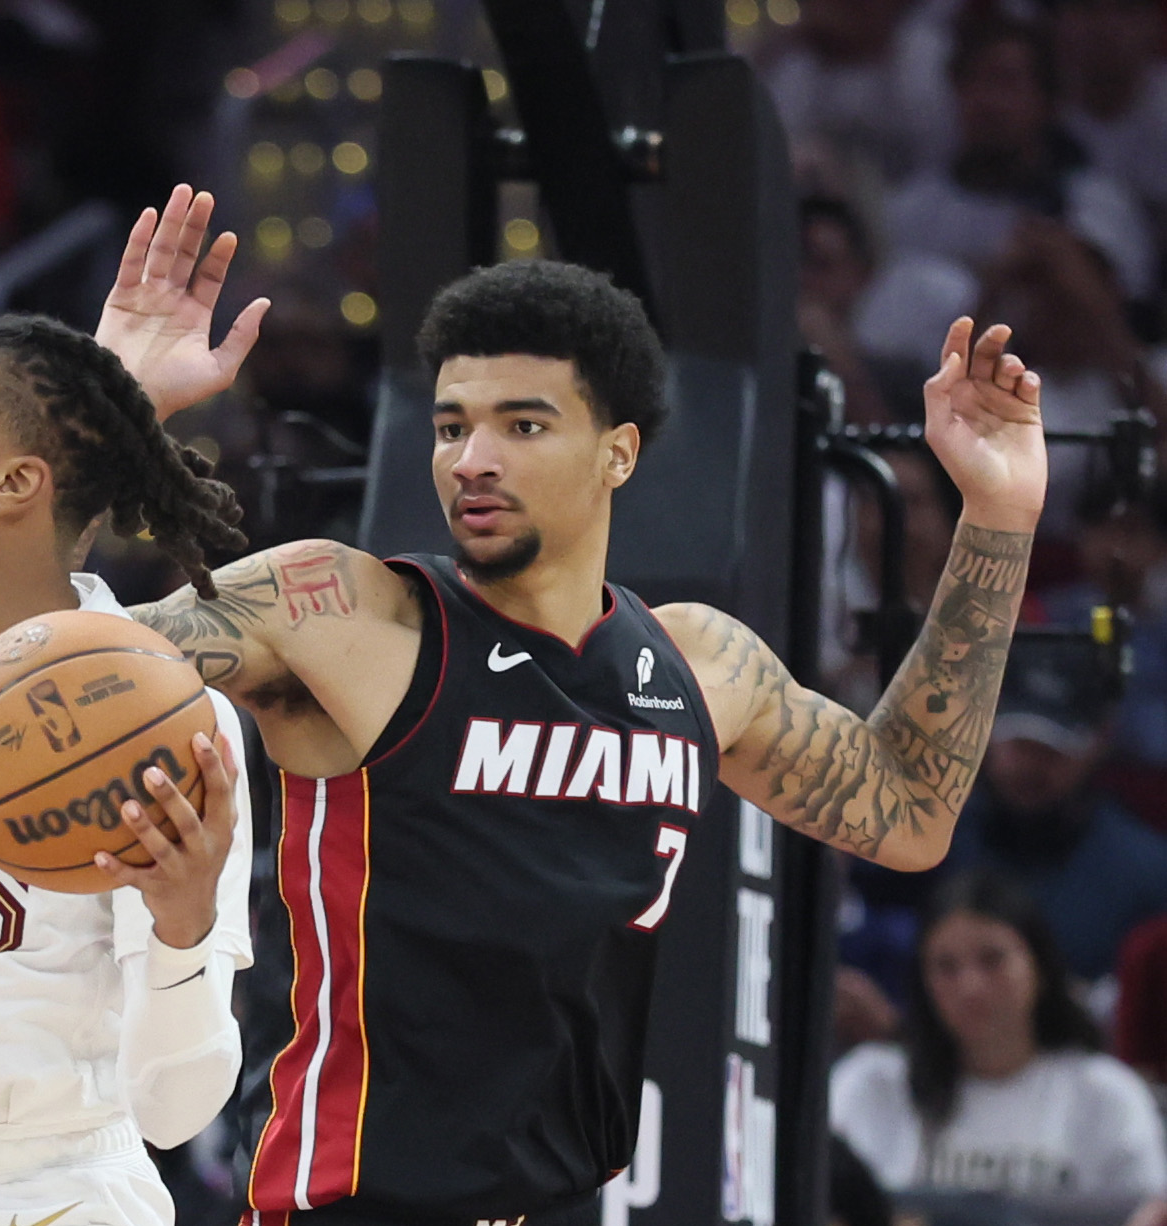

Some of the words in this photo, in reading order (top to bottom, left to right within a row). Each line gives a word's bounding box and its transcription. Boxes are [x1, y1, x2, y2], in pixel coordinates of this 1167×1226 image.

[627, 692, 685, 710] Robinhood
[3, 744, 189, 845] Wilson
[451, 716, 699, 814] MIAMI
[627, 822, 688, 932] 7
